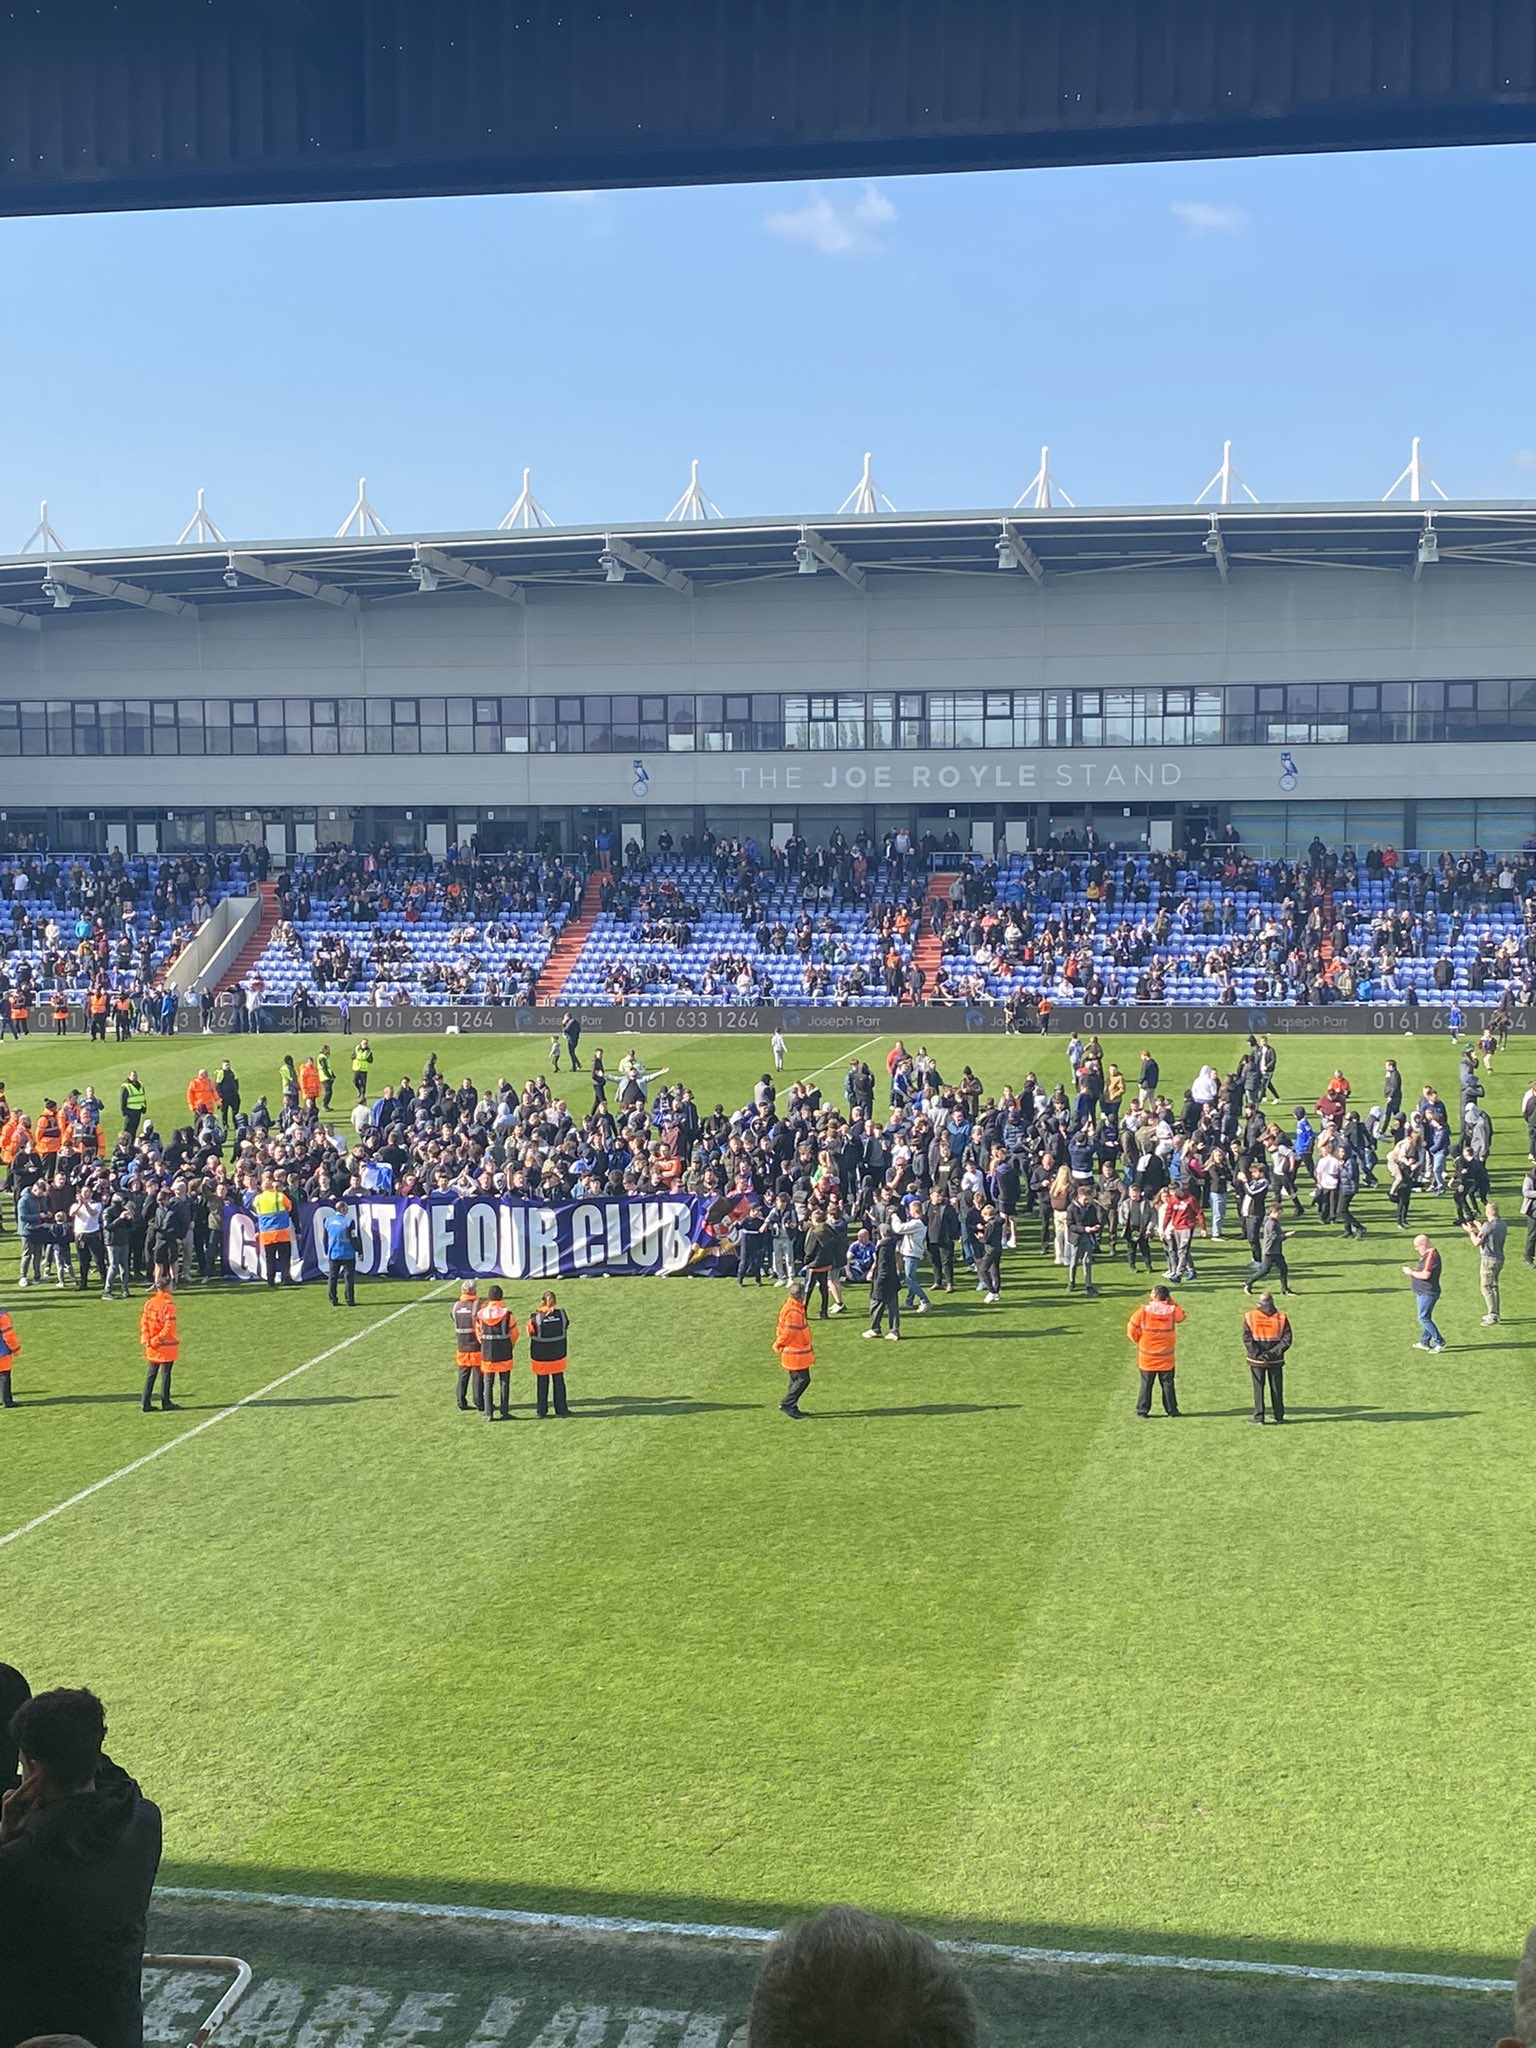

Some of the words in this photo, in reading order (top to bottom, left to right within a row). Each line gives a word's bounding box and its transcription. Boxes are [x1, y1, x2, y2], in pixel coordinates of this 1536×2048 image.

[735, 767, 802, 789] THE
[823, 766, 891, 788] JOE
[912, 765, 1036, 788] ROYLE
[1056, 763, 1181, 786] STAND
[362, 1011, 402, 1028] 0161
[412, 1011, 443, 1028] 633
[453, 1011, 494, 1028] 1264
[581, 1015, 603, 1026] Parr
[624, 1011, 665, 1028] 0161
[676, 1011, 707, 1028] 633
[717, 1011, 759, 1028] 1264
[808, 1015, 853, 1028] Joseph
[856, 1015, 881, 1027] Parr
[1083, 1011, 1127, 1029] 0161
[1138, 1011, 1173, 1029] 633
[1182, 1011, 1229, 1029] 1264
[1273, 1016, 1319, 1029] Joseph
[1323, 1015, 1349, 1027] Parr
[1373, 1011, 1420, 1029] 0161
[403, 1203, 455, 1275] OF
[466, 1203, 560, 1279] OUR
[572, 1202, 692, 1275] CLUB
